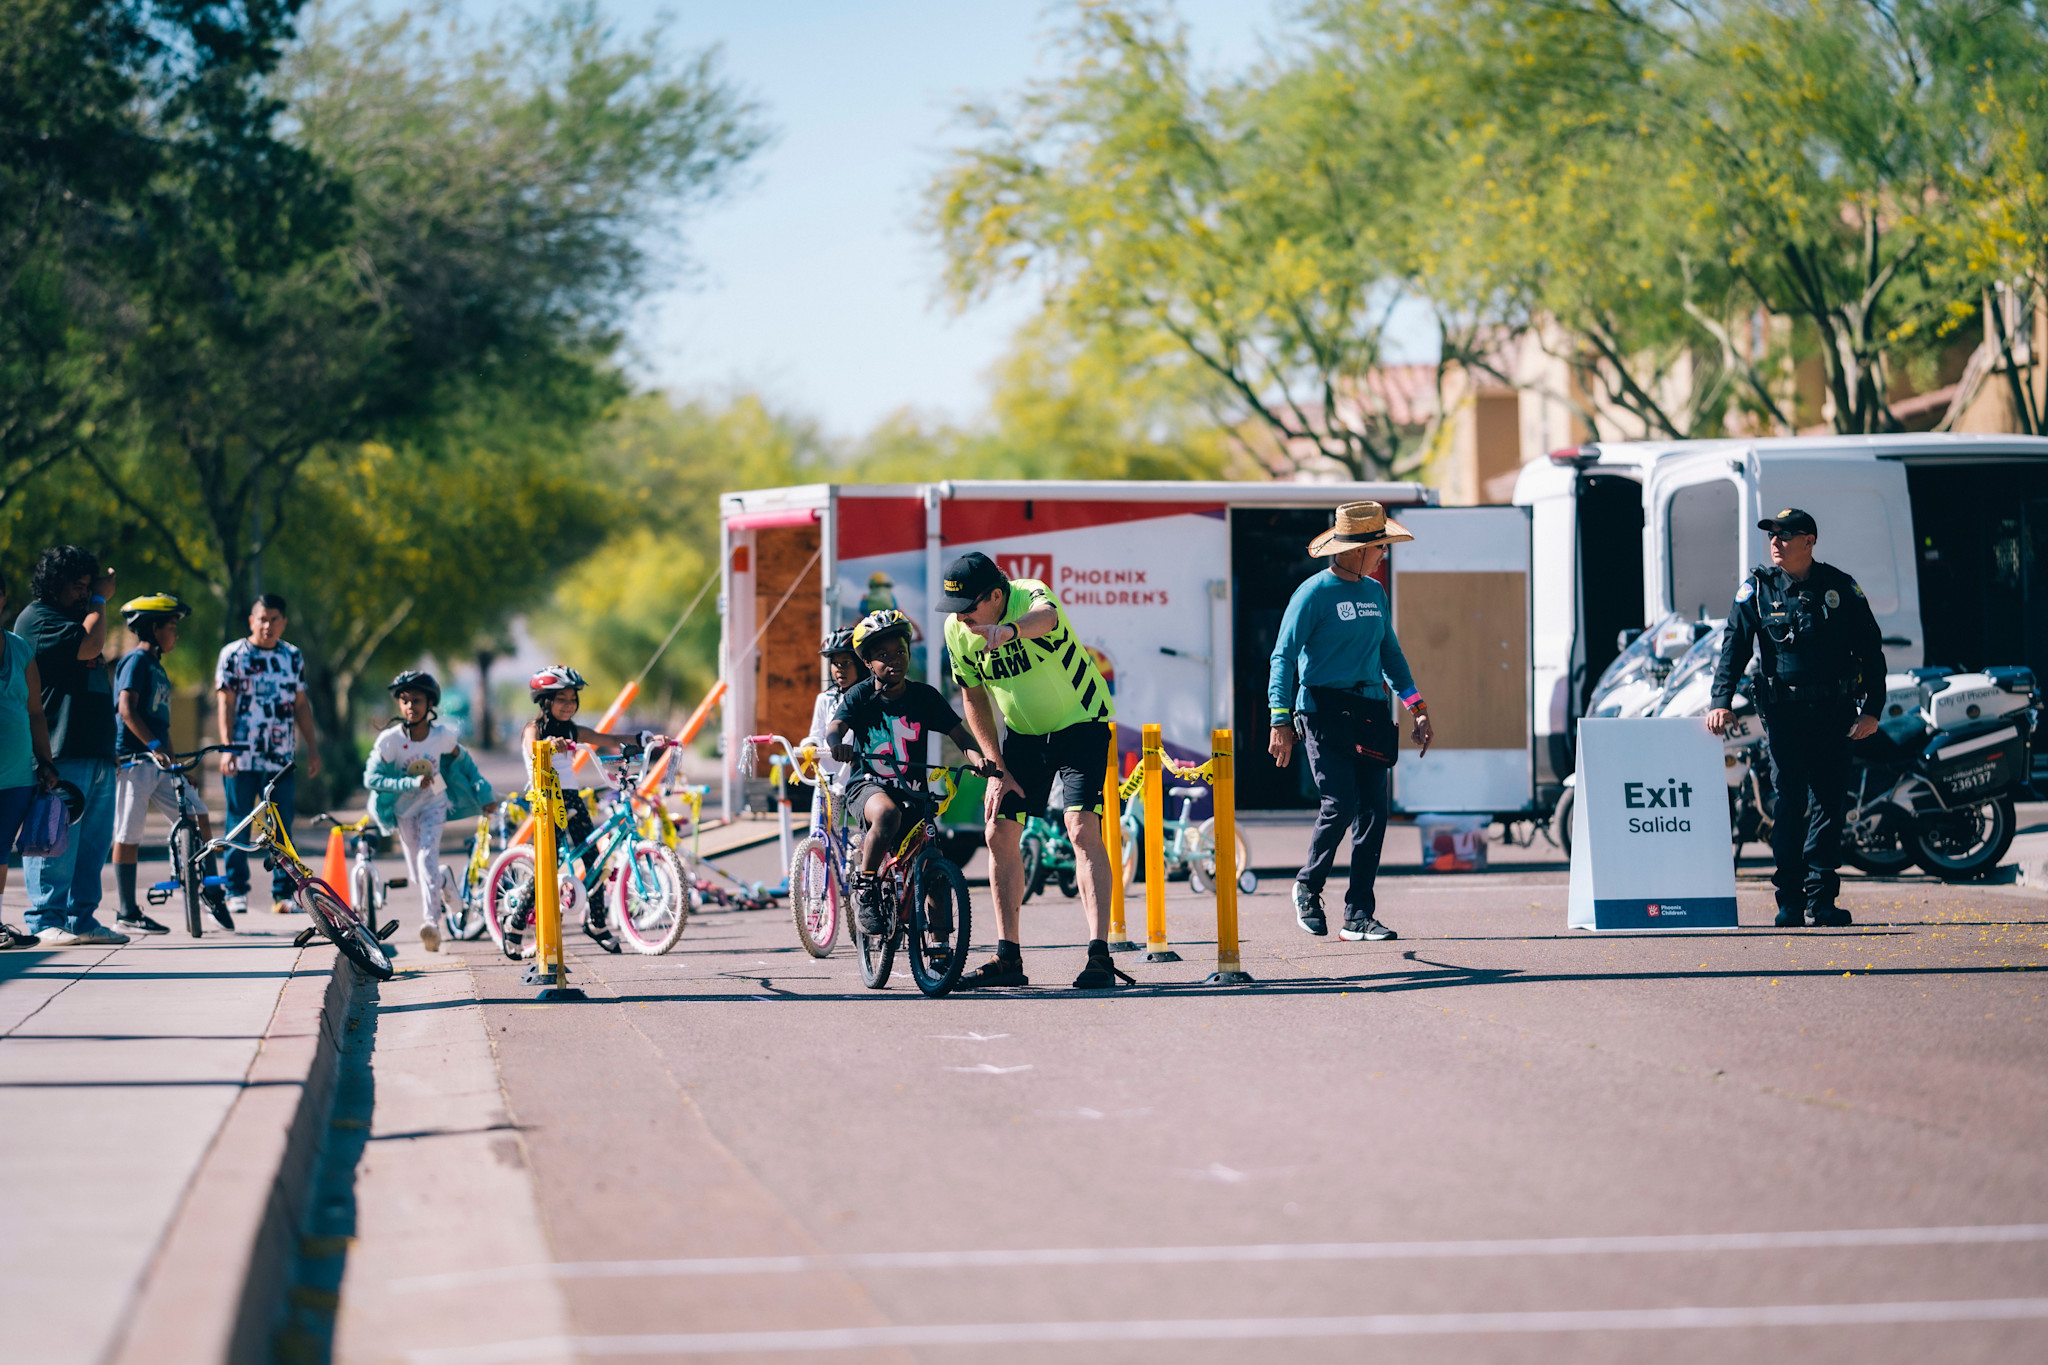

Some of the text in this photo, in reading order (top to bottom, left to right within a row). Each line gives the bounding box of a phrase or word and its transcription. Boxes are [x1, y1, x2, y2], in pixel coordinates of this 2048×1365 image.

[1060, 566, 1147, 584] PHOENIX
[1060, 587, 1169, 606] CHILDREN'S
[1002, 638, 1025, 656] THE
[977, 648, 1033, 681] LAW
[1938, 689, 2000, 706] City of Phoenix
[1624, 778, 1693, 809] Exit
[1628, 816, 1691, 833] Salida
